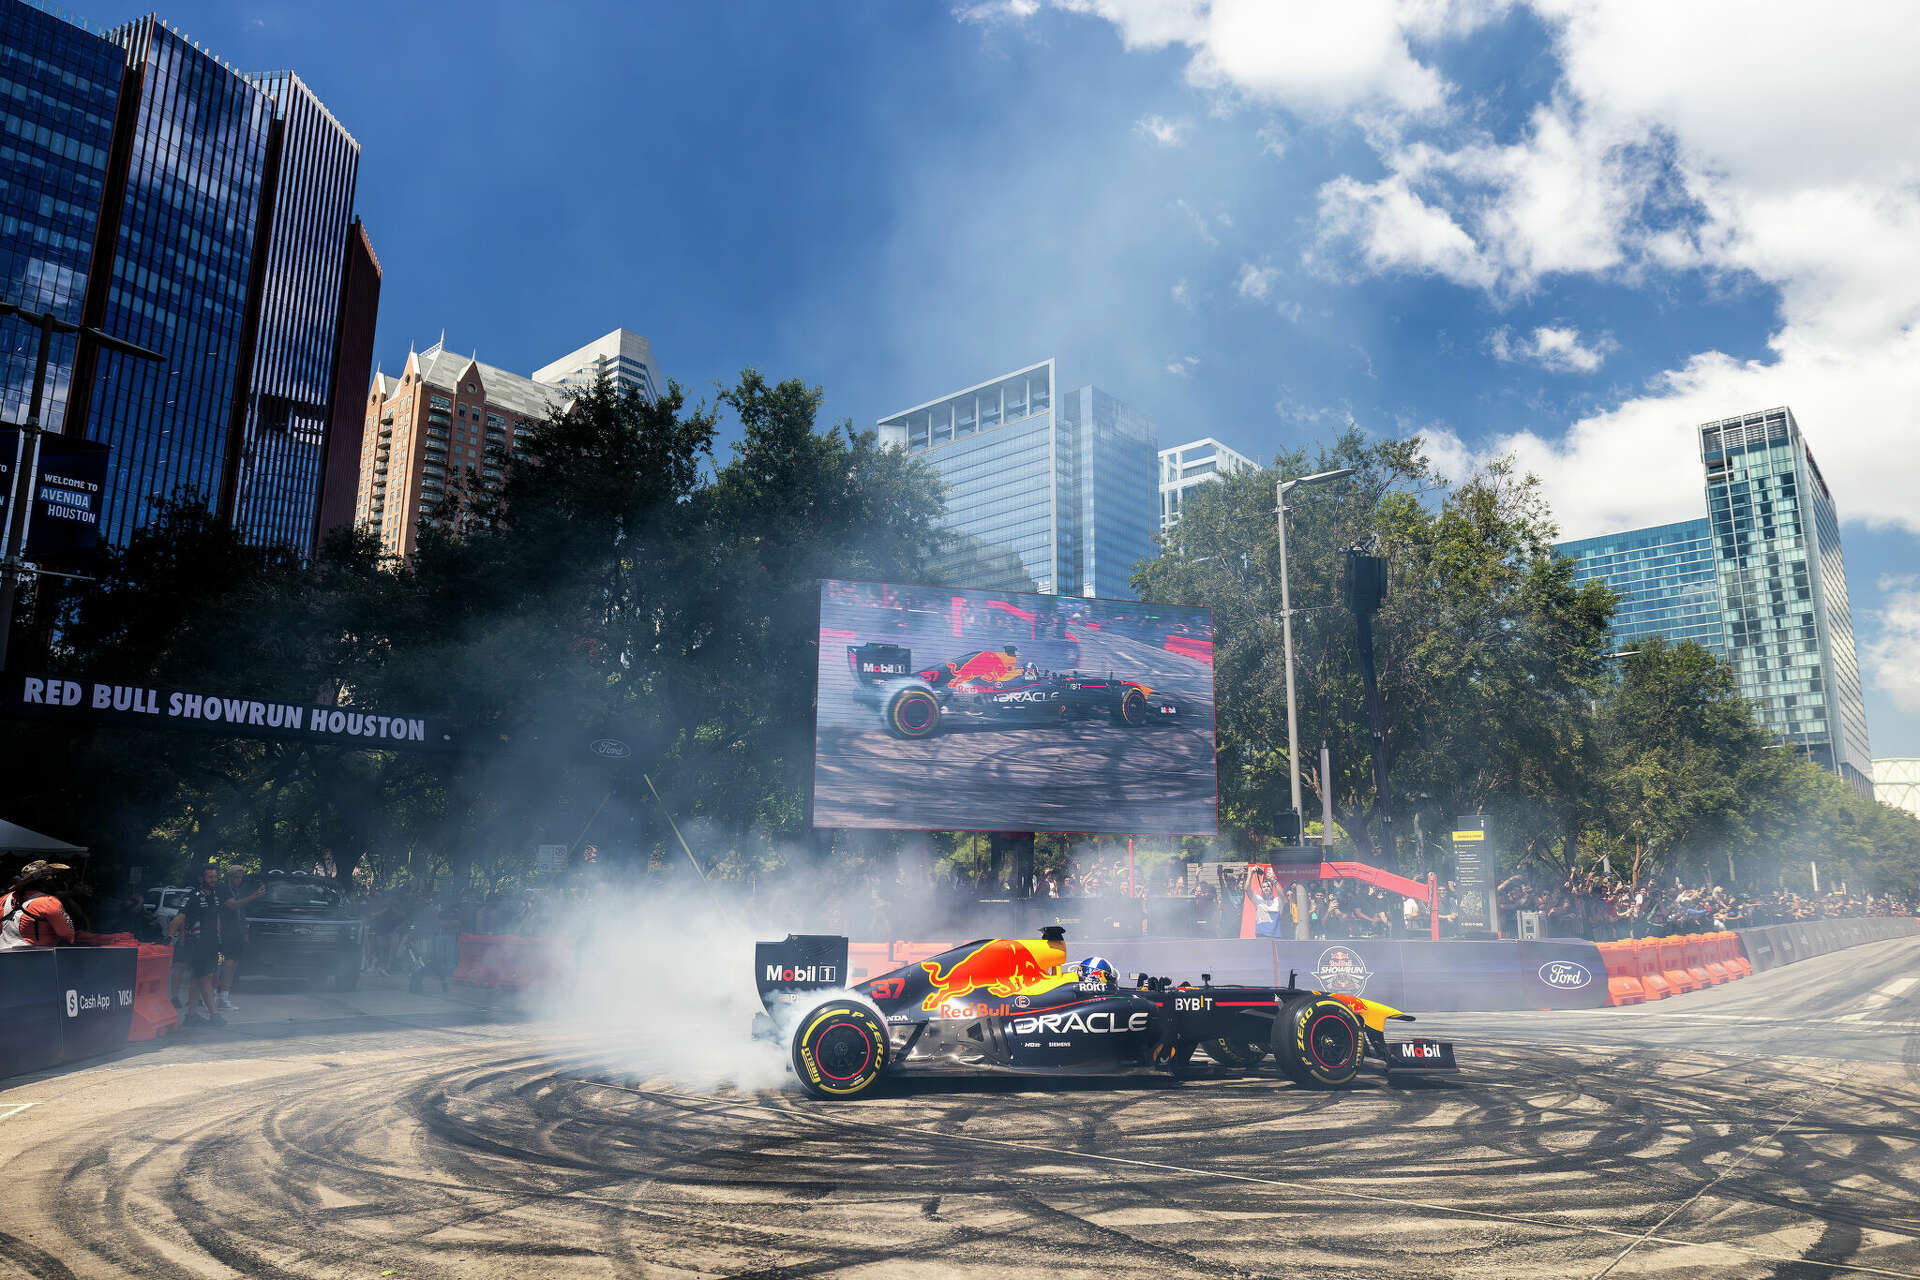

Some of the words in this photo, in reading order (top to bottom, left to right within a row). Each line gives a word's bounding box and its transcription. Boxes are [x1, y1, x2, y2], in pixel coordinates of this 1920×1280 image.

[44, 473, 85, 489] WELCOME
[87, 482, 98, 492] TO
[41, 488, 89, 508] AVENIDA
[47, 504, 96, 524] HOUSTON
[863, 662, 893, 674] Mobil
[919, 670, 940, 682] 37
[23, 676, 83, 707] RED
[92, 683, 160, 715] BULL
[168, 691, 303, 729] SHOWRUN
[310, 708, 425, 741] HOUSTON
[766, 964, 817, 982] Mobil
[1320, 966, 1364, 975] SHOWRUN
[1549, 964, 1582, 985] Ford
[869, 977, 906, 999] 37
[1080, 982, 1107, 992] ROKT
[80, 995, 96, 1010] Cash
[97, 994, 110, 1010] App
[118, 989, 132, 1006] VISA
[1175, 995, 1213, 1011] BYBIT
[940, 1003, 974, 1019] Red
[976, 1003, 1010, 1018] Bull
[1008, 1012, 1149, 1034] ORACLE
[1297, 1007, 1314, 1052] ZERO
[865, 1020, 884, 1070] ZERO
[1402, 1043, 1441, 1058] Mobil
